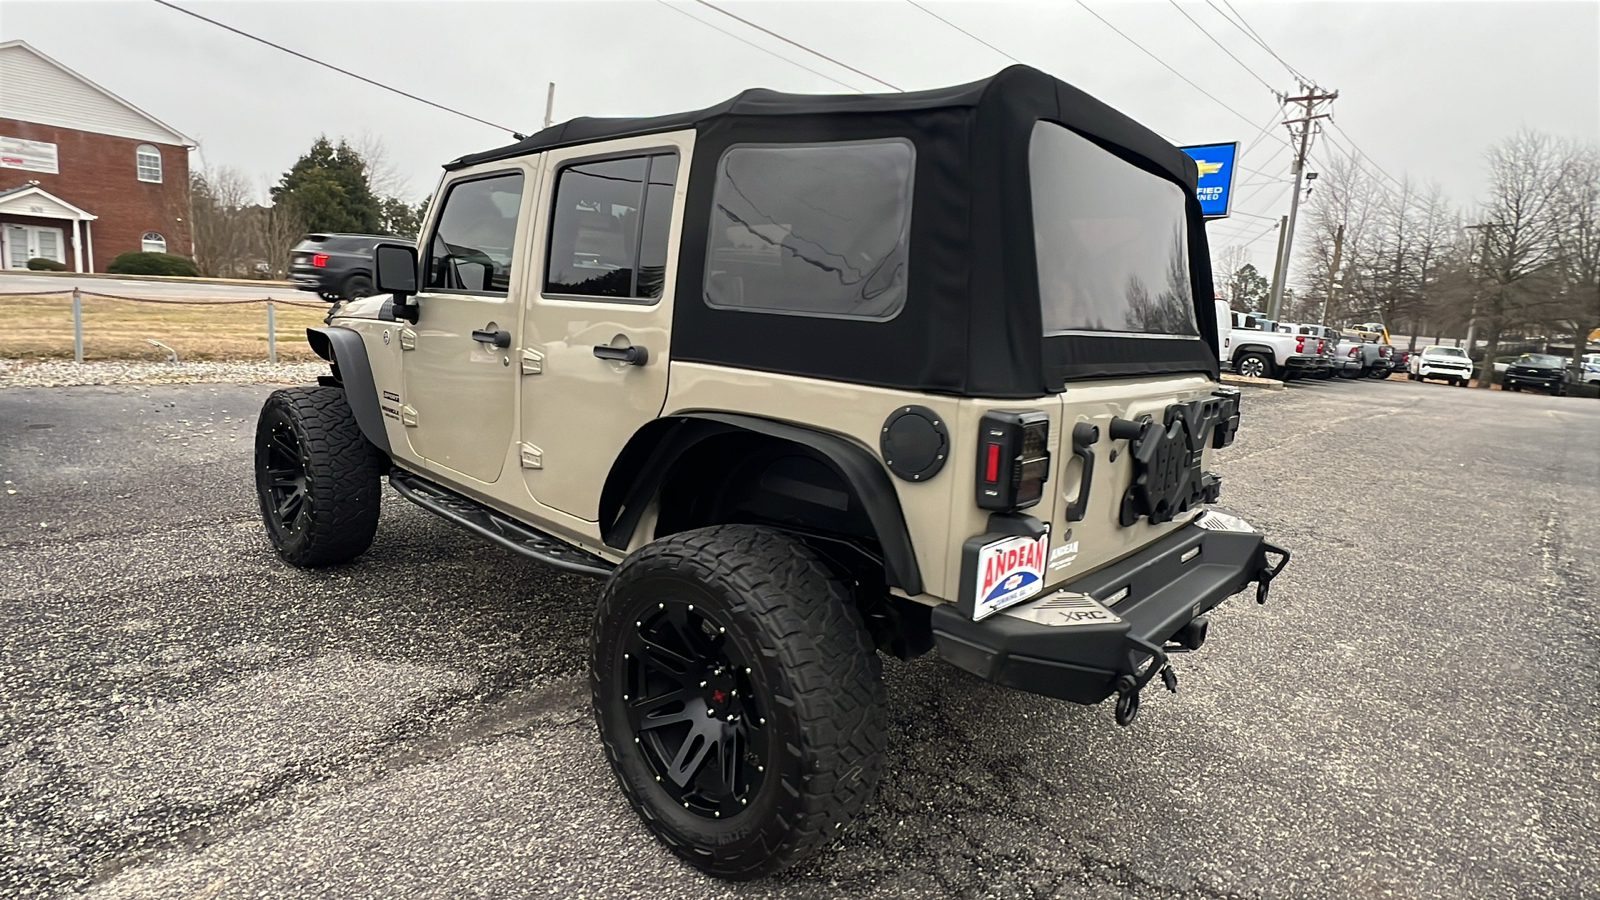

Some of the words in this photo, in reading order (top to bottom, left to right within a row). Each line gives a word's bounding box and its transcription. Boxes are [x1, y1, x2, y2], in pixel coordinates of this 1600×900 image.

[1050, 541, 1079, 561] ANDEAN
[981, 538, 1045, 598] ANDEAN
[1059, 610, 1107, 622] XRC
